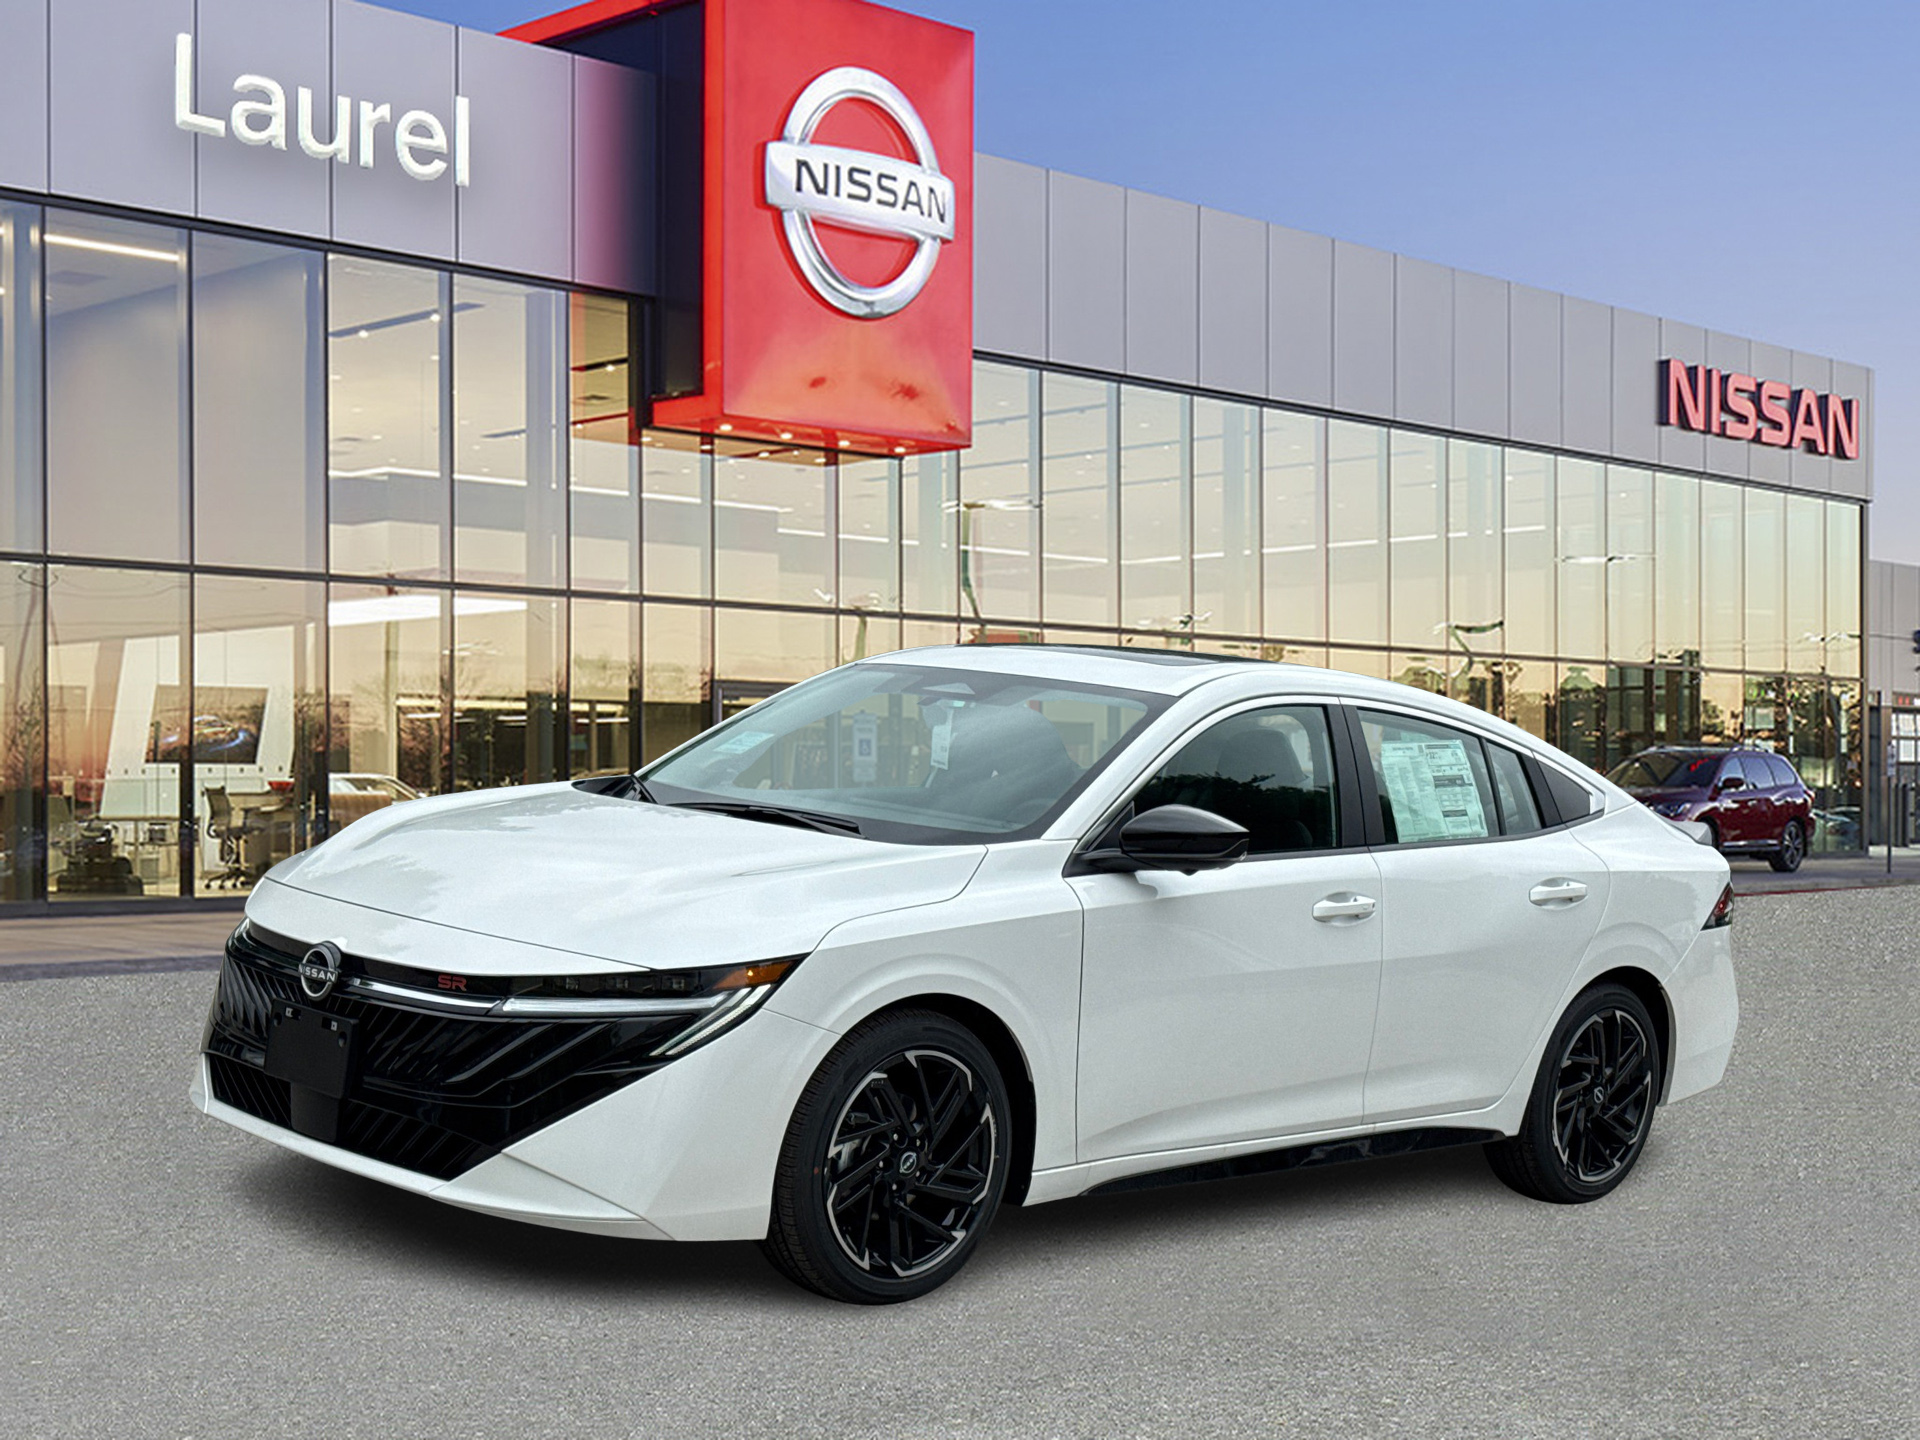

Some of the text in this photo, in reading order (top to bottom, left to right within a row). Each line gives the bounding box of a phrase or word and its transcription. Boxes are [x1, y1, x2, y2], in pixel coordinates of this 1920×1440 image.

[175, 32, 470, 187] Laurel
[795, 158, 946, 223] NISSAN
[1658, 358, 1860, 460] NISSAN
[437, 974, 467, 992] SR
